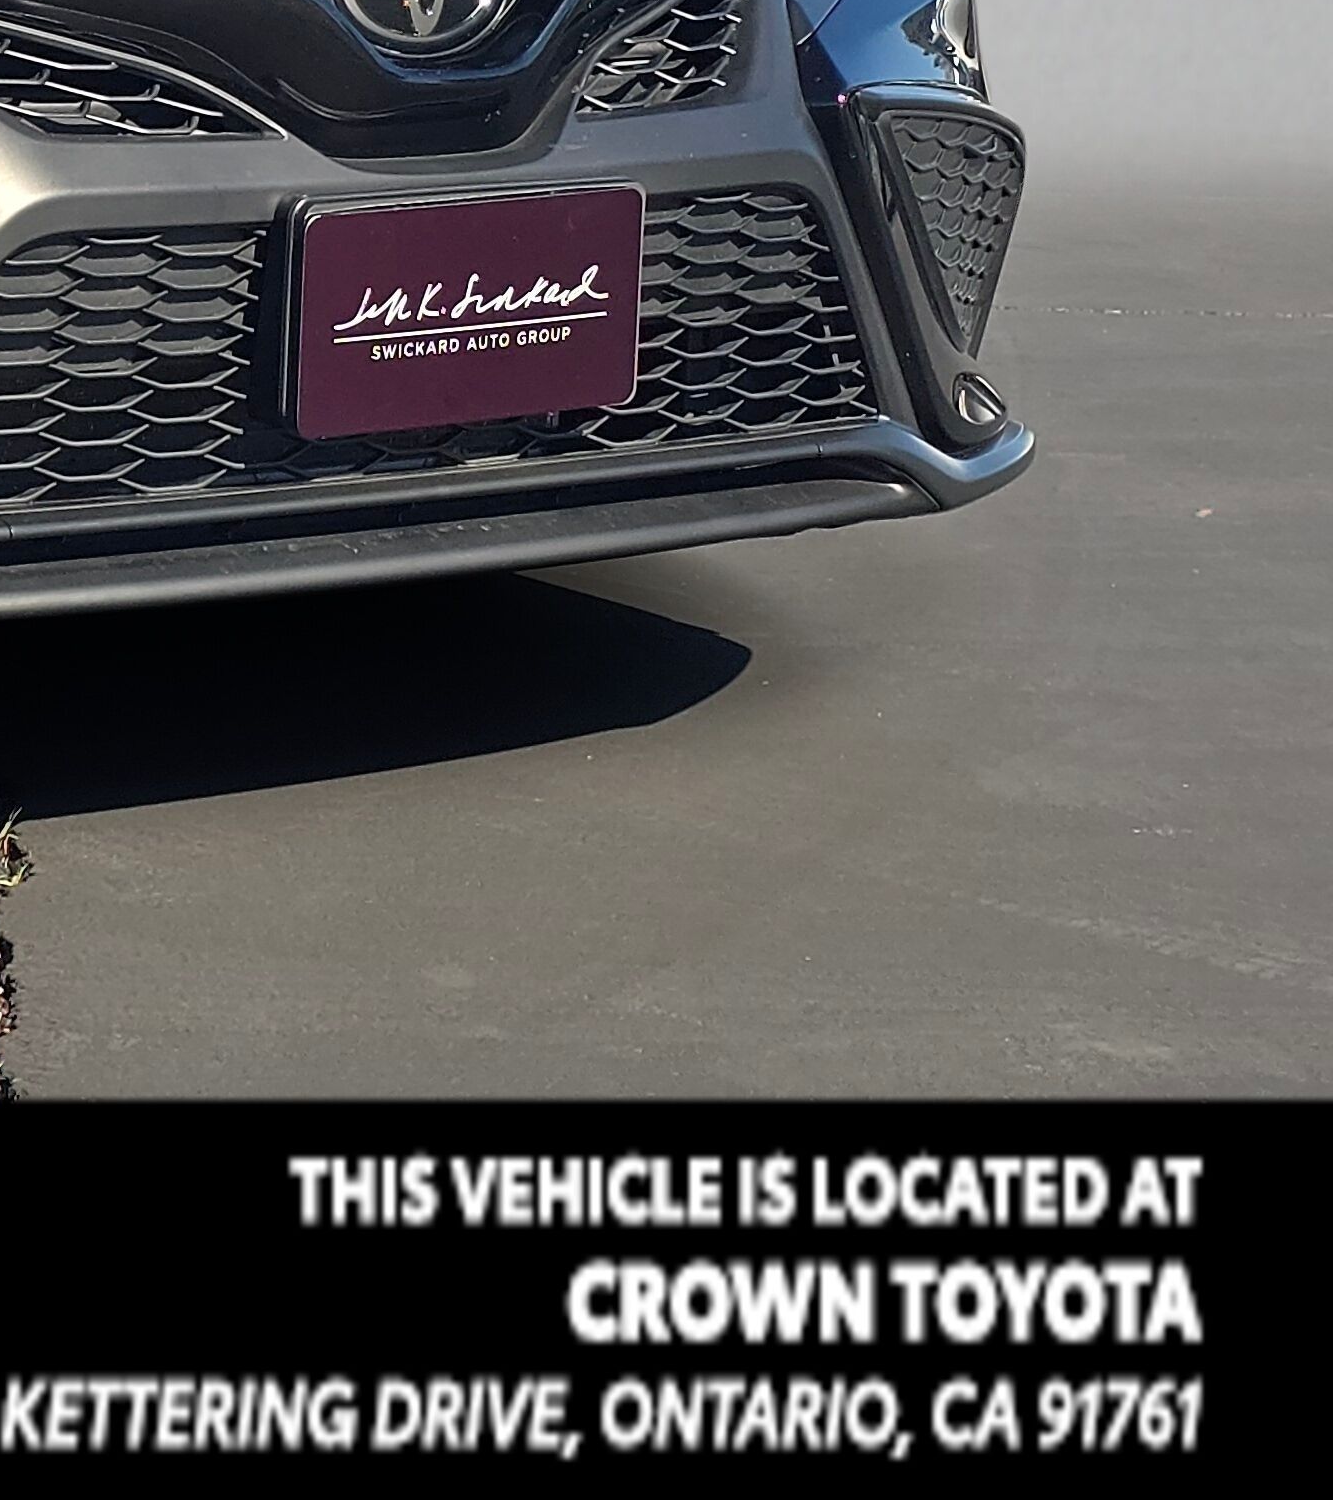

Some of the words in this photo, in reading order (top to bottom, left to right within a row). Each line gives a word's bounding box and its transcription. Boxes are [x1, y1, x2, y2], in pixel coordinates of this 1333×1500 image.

[370, 338, 460, 361] SWICKARD
[466, 332, 511, 351] AUTO
[516, 326, 572, 346] GROUP
